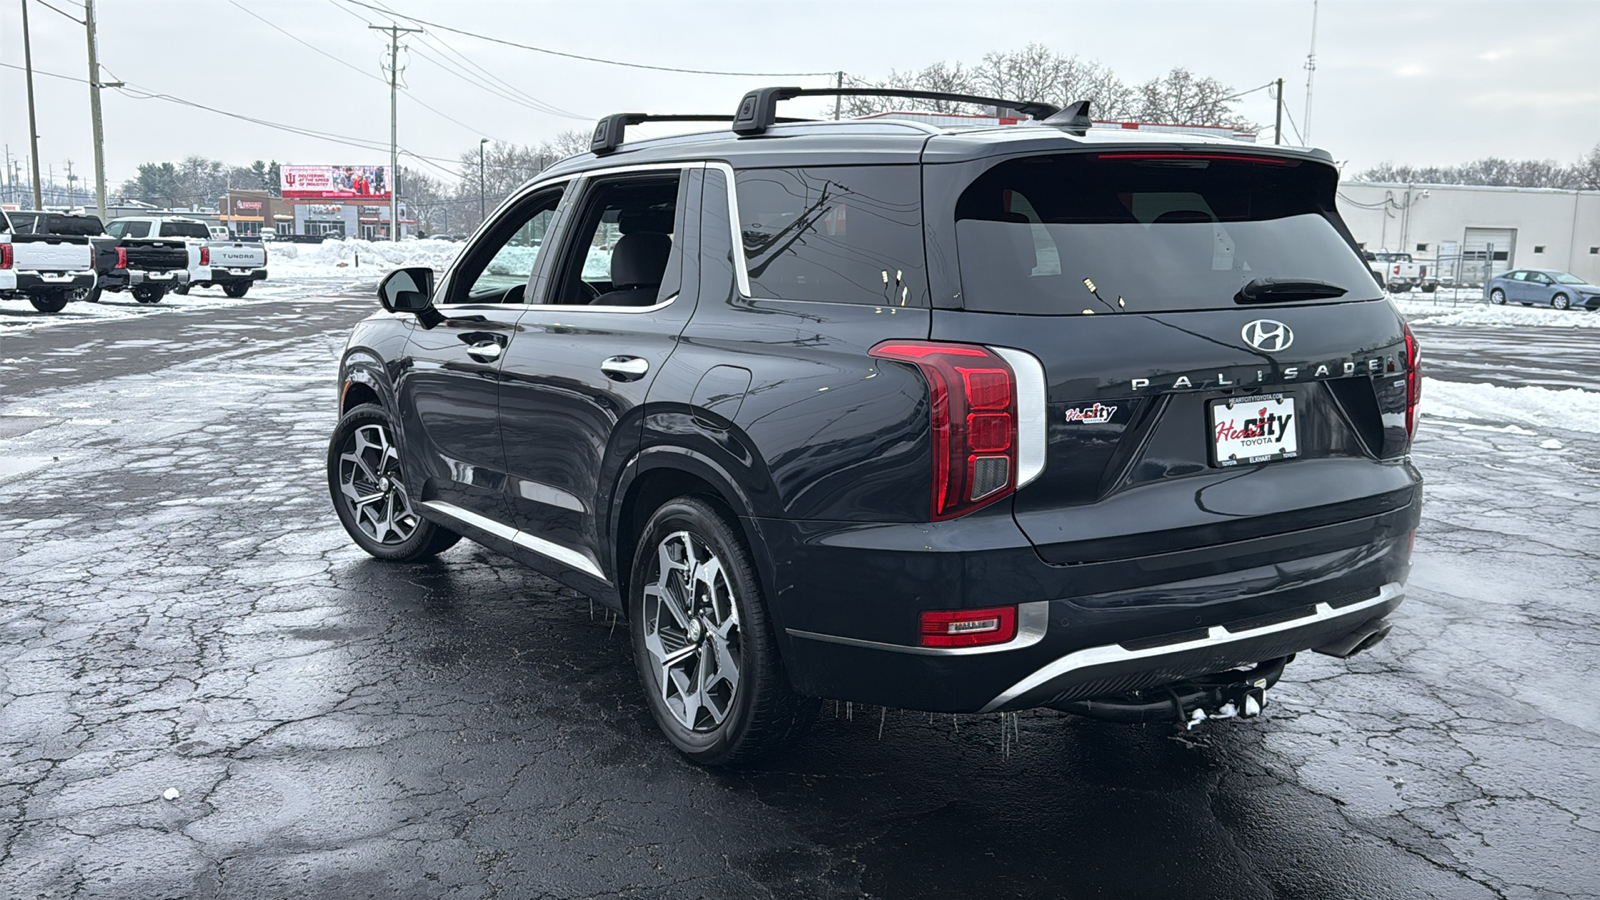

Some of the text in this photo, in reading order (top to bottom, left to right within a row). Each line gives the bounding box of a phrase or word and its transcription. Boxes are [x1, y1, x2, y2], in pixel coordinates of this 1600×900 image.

[1131, 358, 1379, 391] PALISADE
[1228, 393, 1284, 403] HEARTCITYTOYOTA.COM
[1215, 407, 1293, 443] Heart city
[1240, 437, 1273, 447] TOYOTA
[1249, 455, 1271, 463] ELKHART
